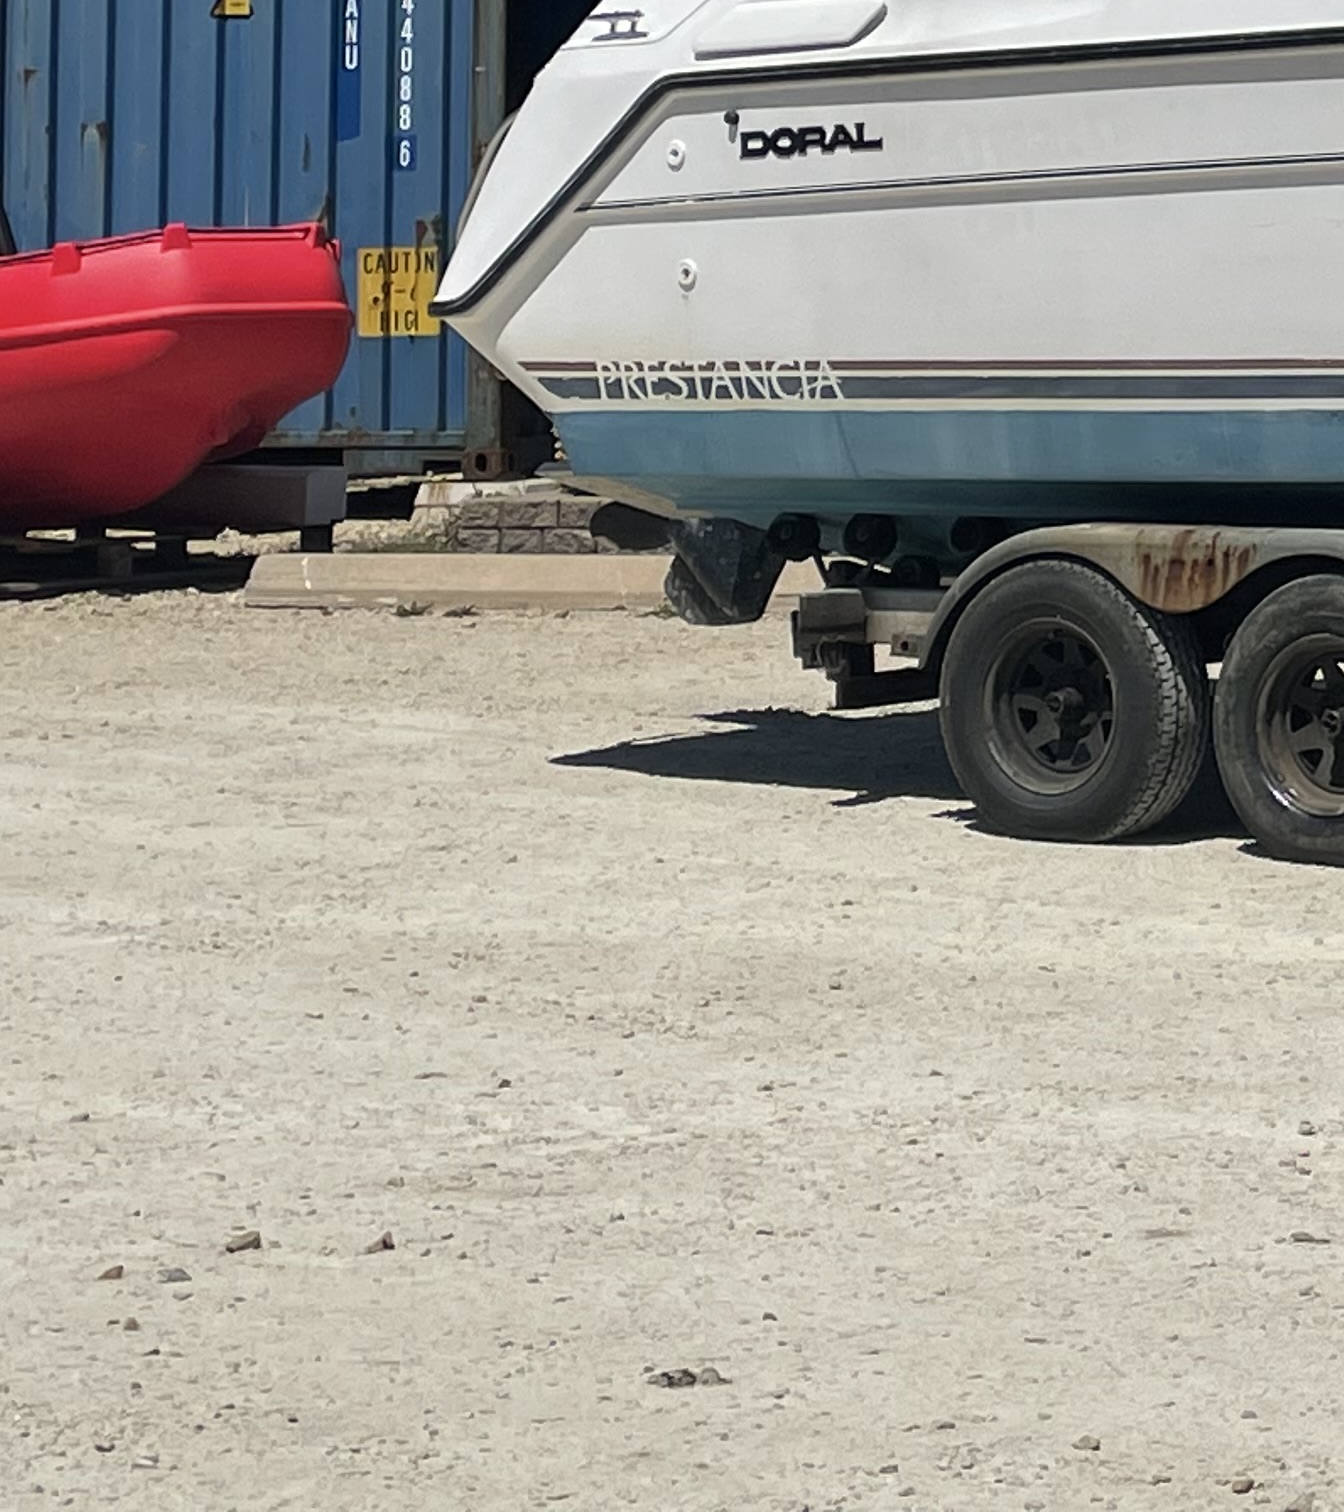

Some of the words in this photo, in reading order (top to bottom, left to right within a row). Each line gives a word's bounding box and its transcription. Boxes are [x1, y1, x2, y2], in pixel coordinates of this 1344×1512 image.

[739, 122, 884, 160] DORAL
[363, 251, 435, 274] CAUTN
[595, 360, 845, 400] PRESTANCIA
